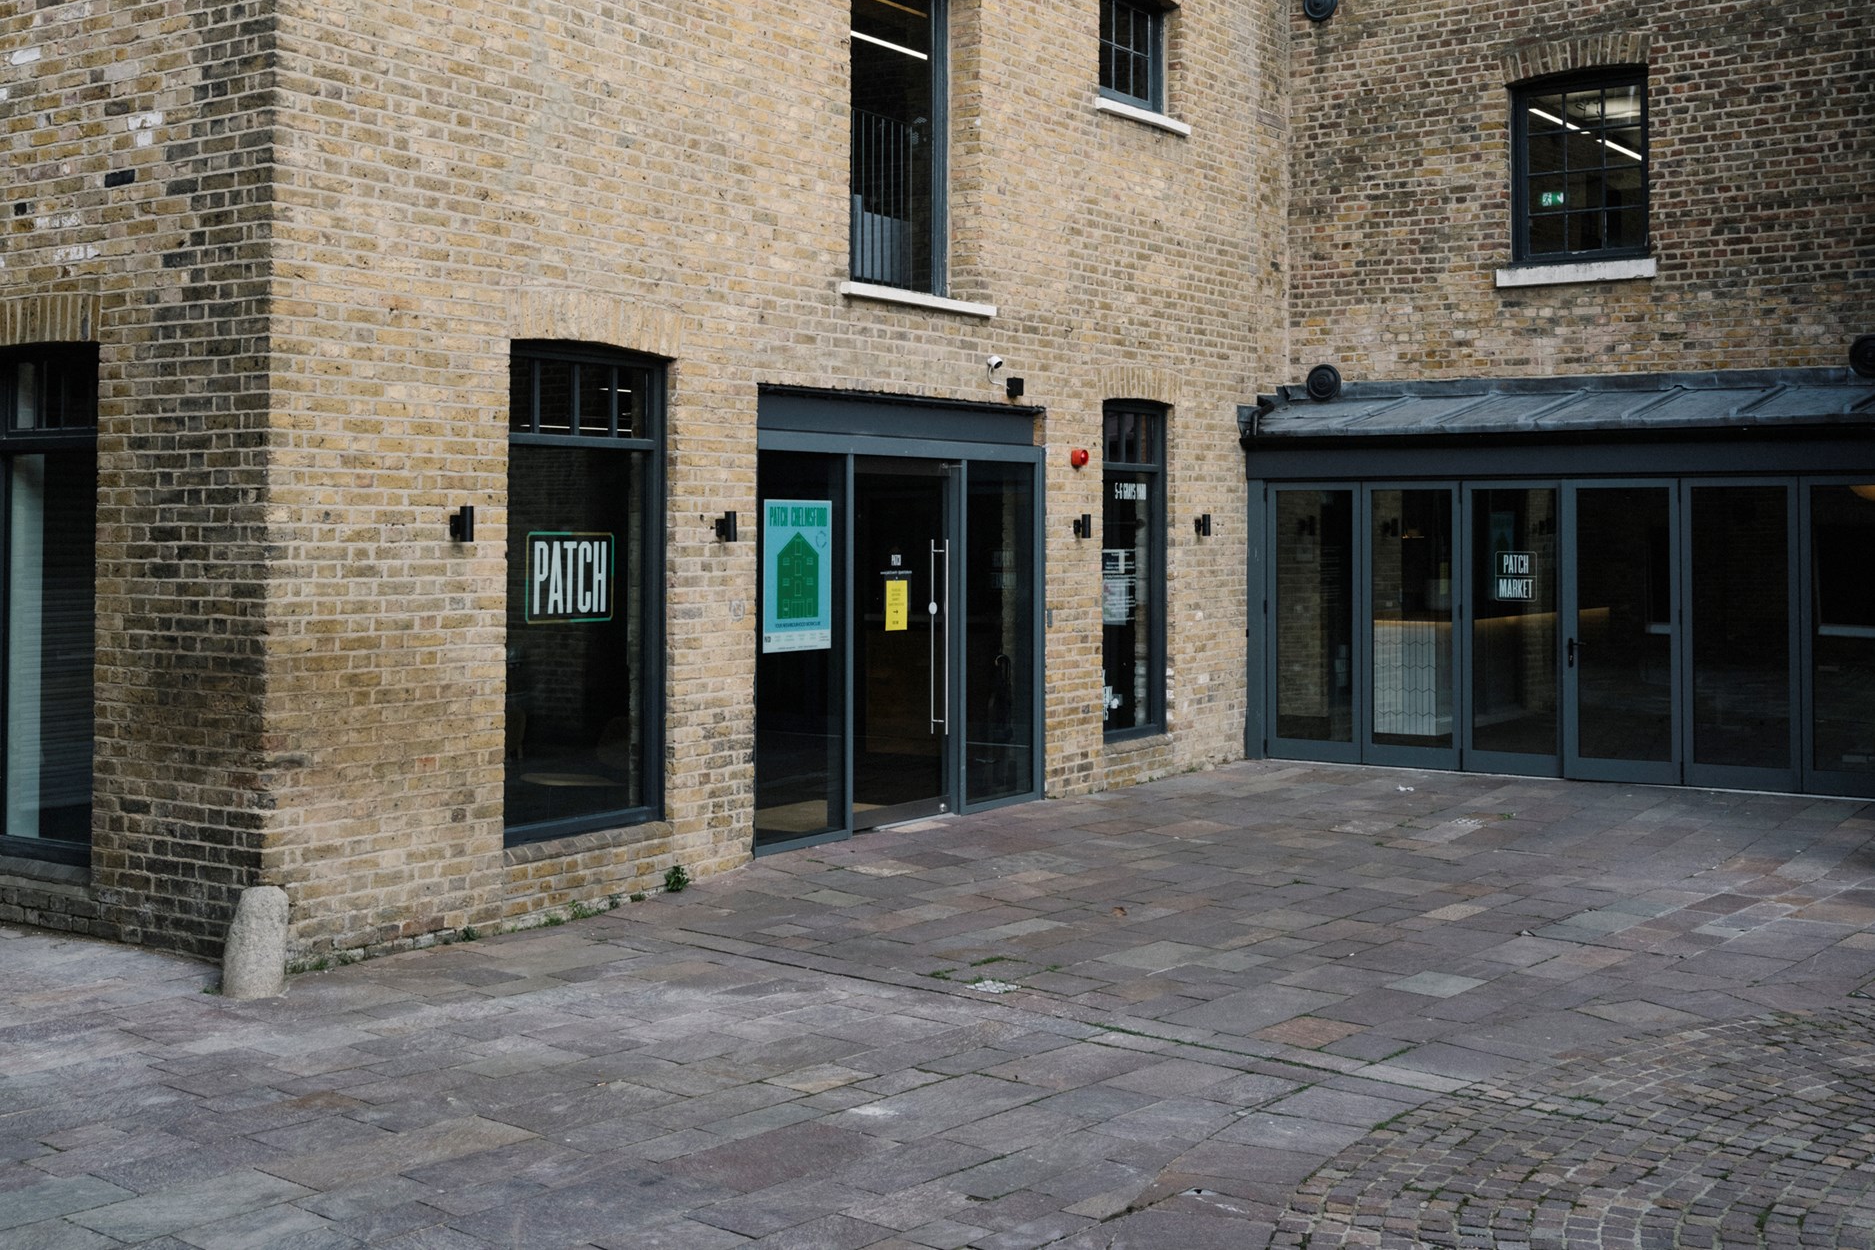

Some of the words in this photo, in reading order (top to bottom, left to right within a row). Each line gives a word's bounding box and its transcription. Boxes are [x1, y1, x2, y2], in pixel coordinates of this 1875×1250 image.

[1115, 482, 1123, 500] 5-6
[769, 506, 788, 527] PATCH
[790, 507, 827, 527] CHELMSFORD
[1503, 554, 1529, 574] PATCH
[533, 541, 607, 615] PATCH
[1498, 578, 1533, 599] MARKET
